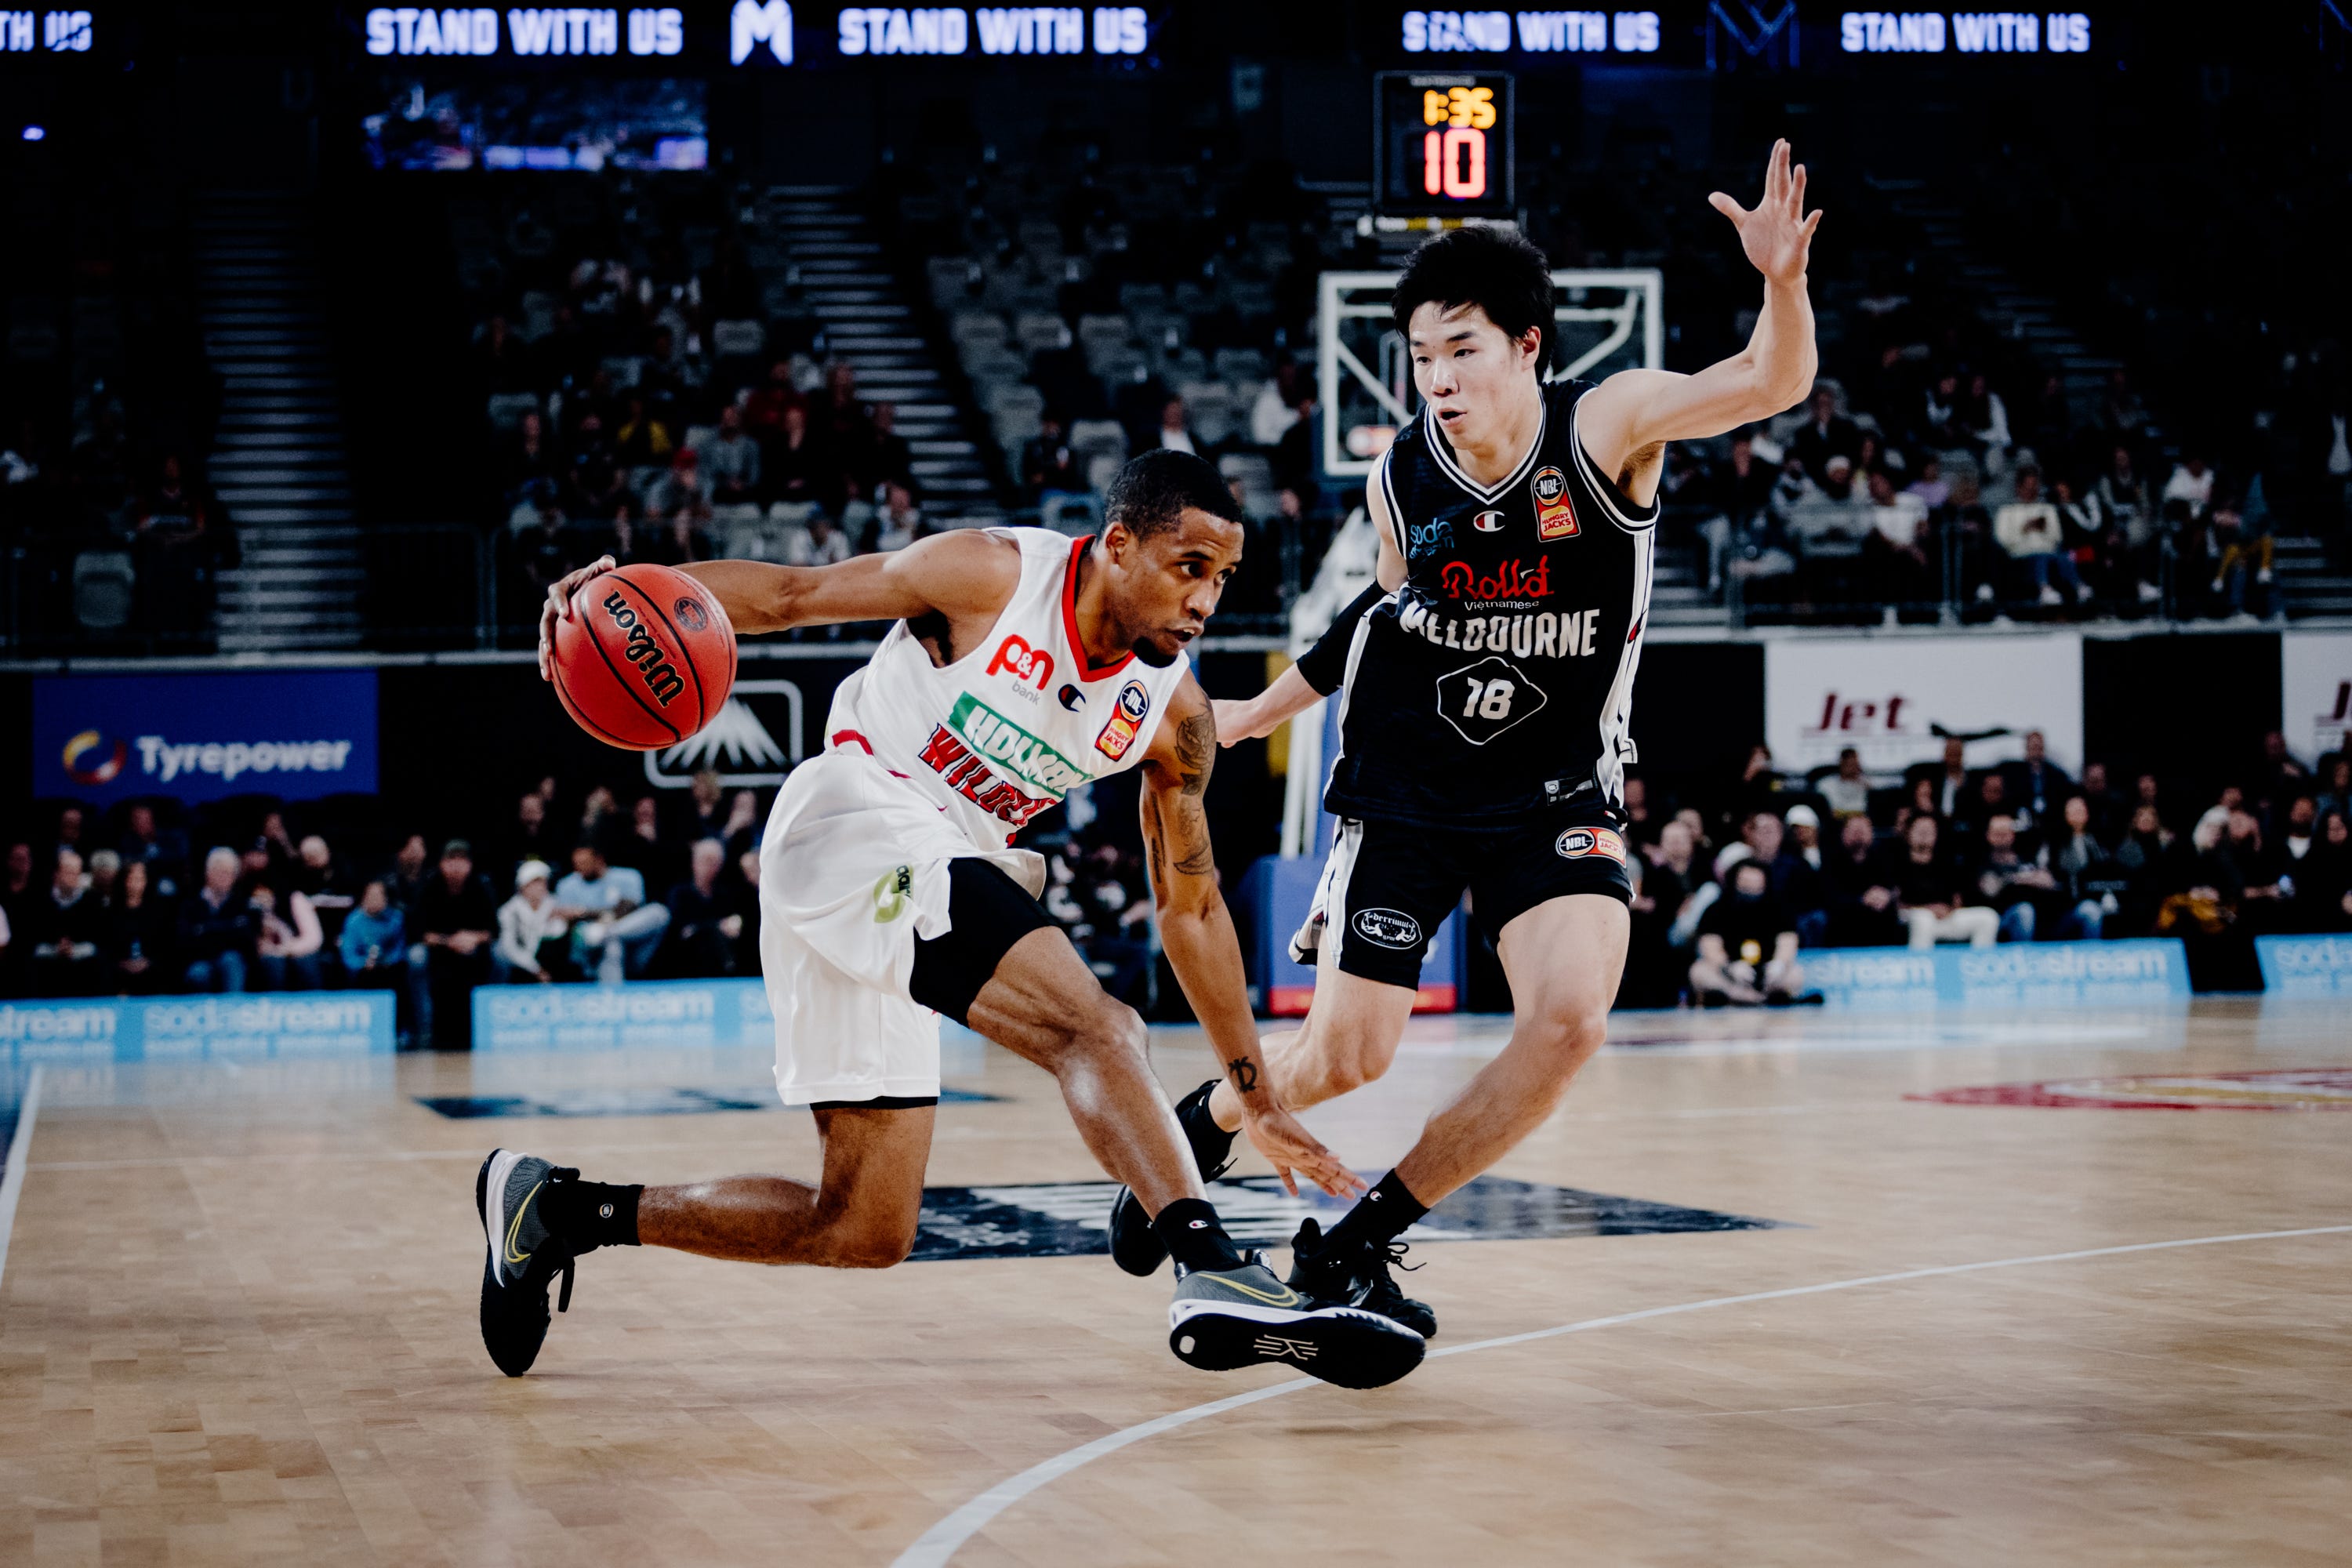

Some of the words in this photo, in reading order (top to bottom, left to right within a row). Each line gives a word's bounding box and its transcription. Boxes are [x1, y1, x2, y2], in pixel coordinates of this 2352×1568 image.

[0, 11, 34, 52] TH
[45, 11, 92, 52] US
[367, 8, 498, 56] STAND
[507, 8, 618, 56] WITH
[628, 8, 683, 55] US
[838, 8, 967, 55] STAND
[976, 7, 1083, 54] WITH
[1093, 7, 1147, 54] US
[1403, 11, 1511, 52] STAND
[1516, 11, 1606, 52] WITH
[1613, 11, 1659, 52] US
[1842, 12, 1945, 53] STAND
[1952, 13, 2038, 53] WITH
[2047, 13, 2089, 53] US
[1424, 86, 1497, 129] 1:35
[1424, 128, 1486, 198] 10
[1540, 478, 1559, 495] NBL
[1542, 512, 1569, 524] HUNGRY
[602, 590, 685, 709] Wilson
[1399, 600, 1600, 659] MELBOURNE
[1011, 680, 1040, 706] bank
[1463, 677, 1515, 720] 18
[136, 735, 352, 782] Tyrepower
[1565, 836, 1588, 851] NBL
[1812, 953, 1935, 985] stream
